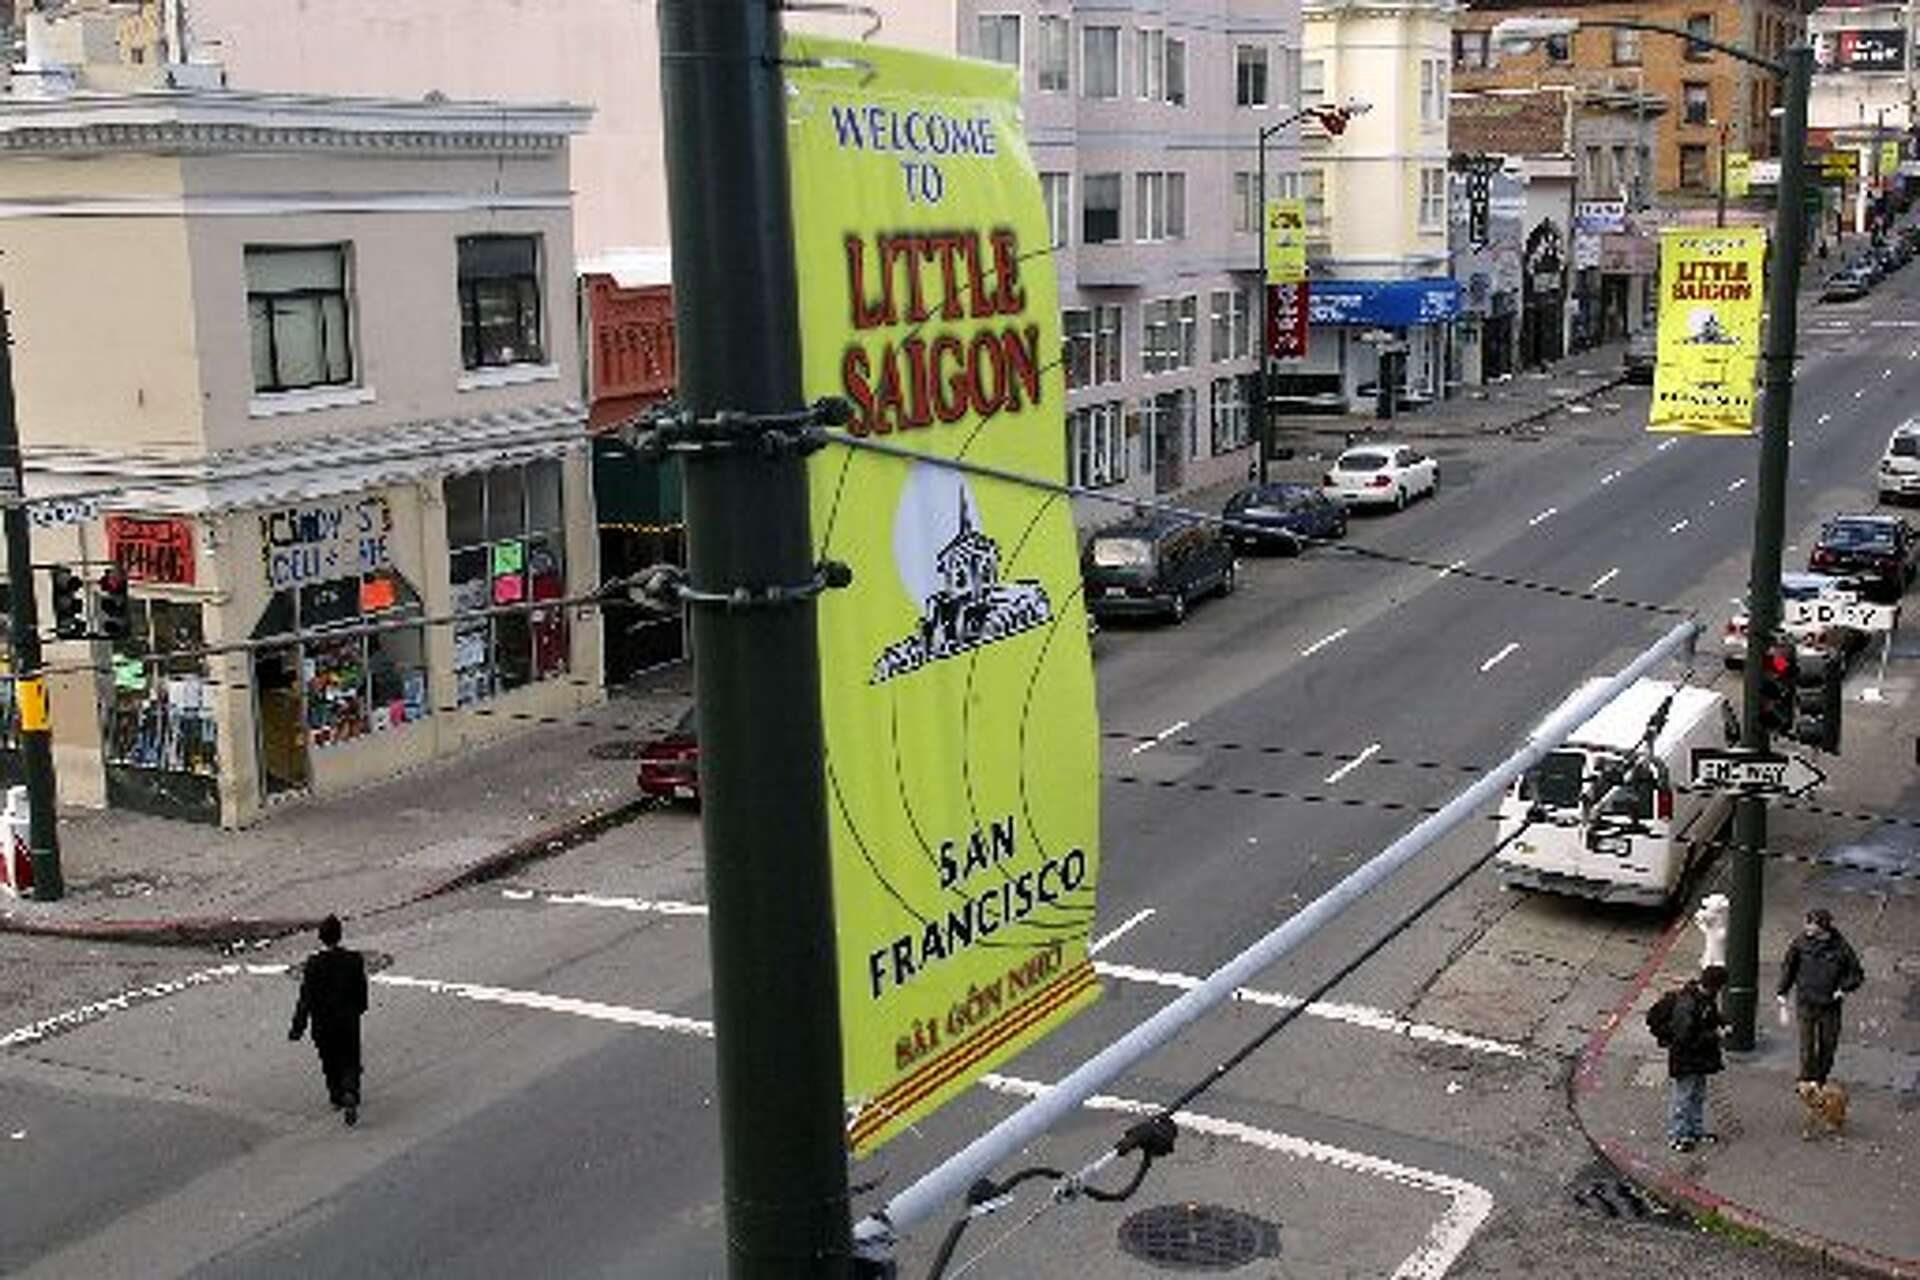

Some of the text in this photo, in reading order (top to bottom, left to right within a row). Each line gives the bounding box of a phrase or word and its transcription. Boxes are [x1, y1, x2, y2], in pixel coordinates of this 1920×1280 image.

[832, 105, 996, 155] WELCOME
[903, 162, 944, 203] TO
[844, 226, 1026, 331] LITTLE
[1672, 283, 1751, 300] SAIGON
[1679, 262, 1748, 281] LITTLE
[842, 324, 1041, 438] SAIGON
[940, 814, 1015, 889] SAN
[869, 848, 1086, 1000] FRANCISCO
